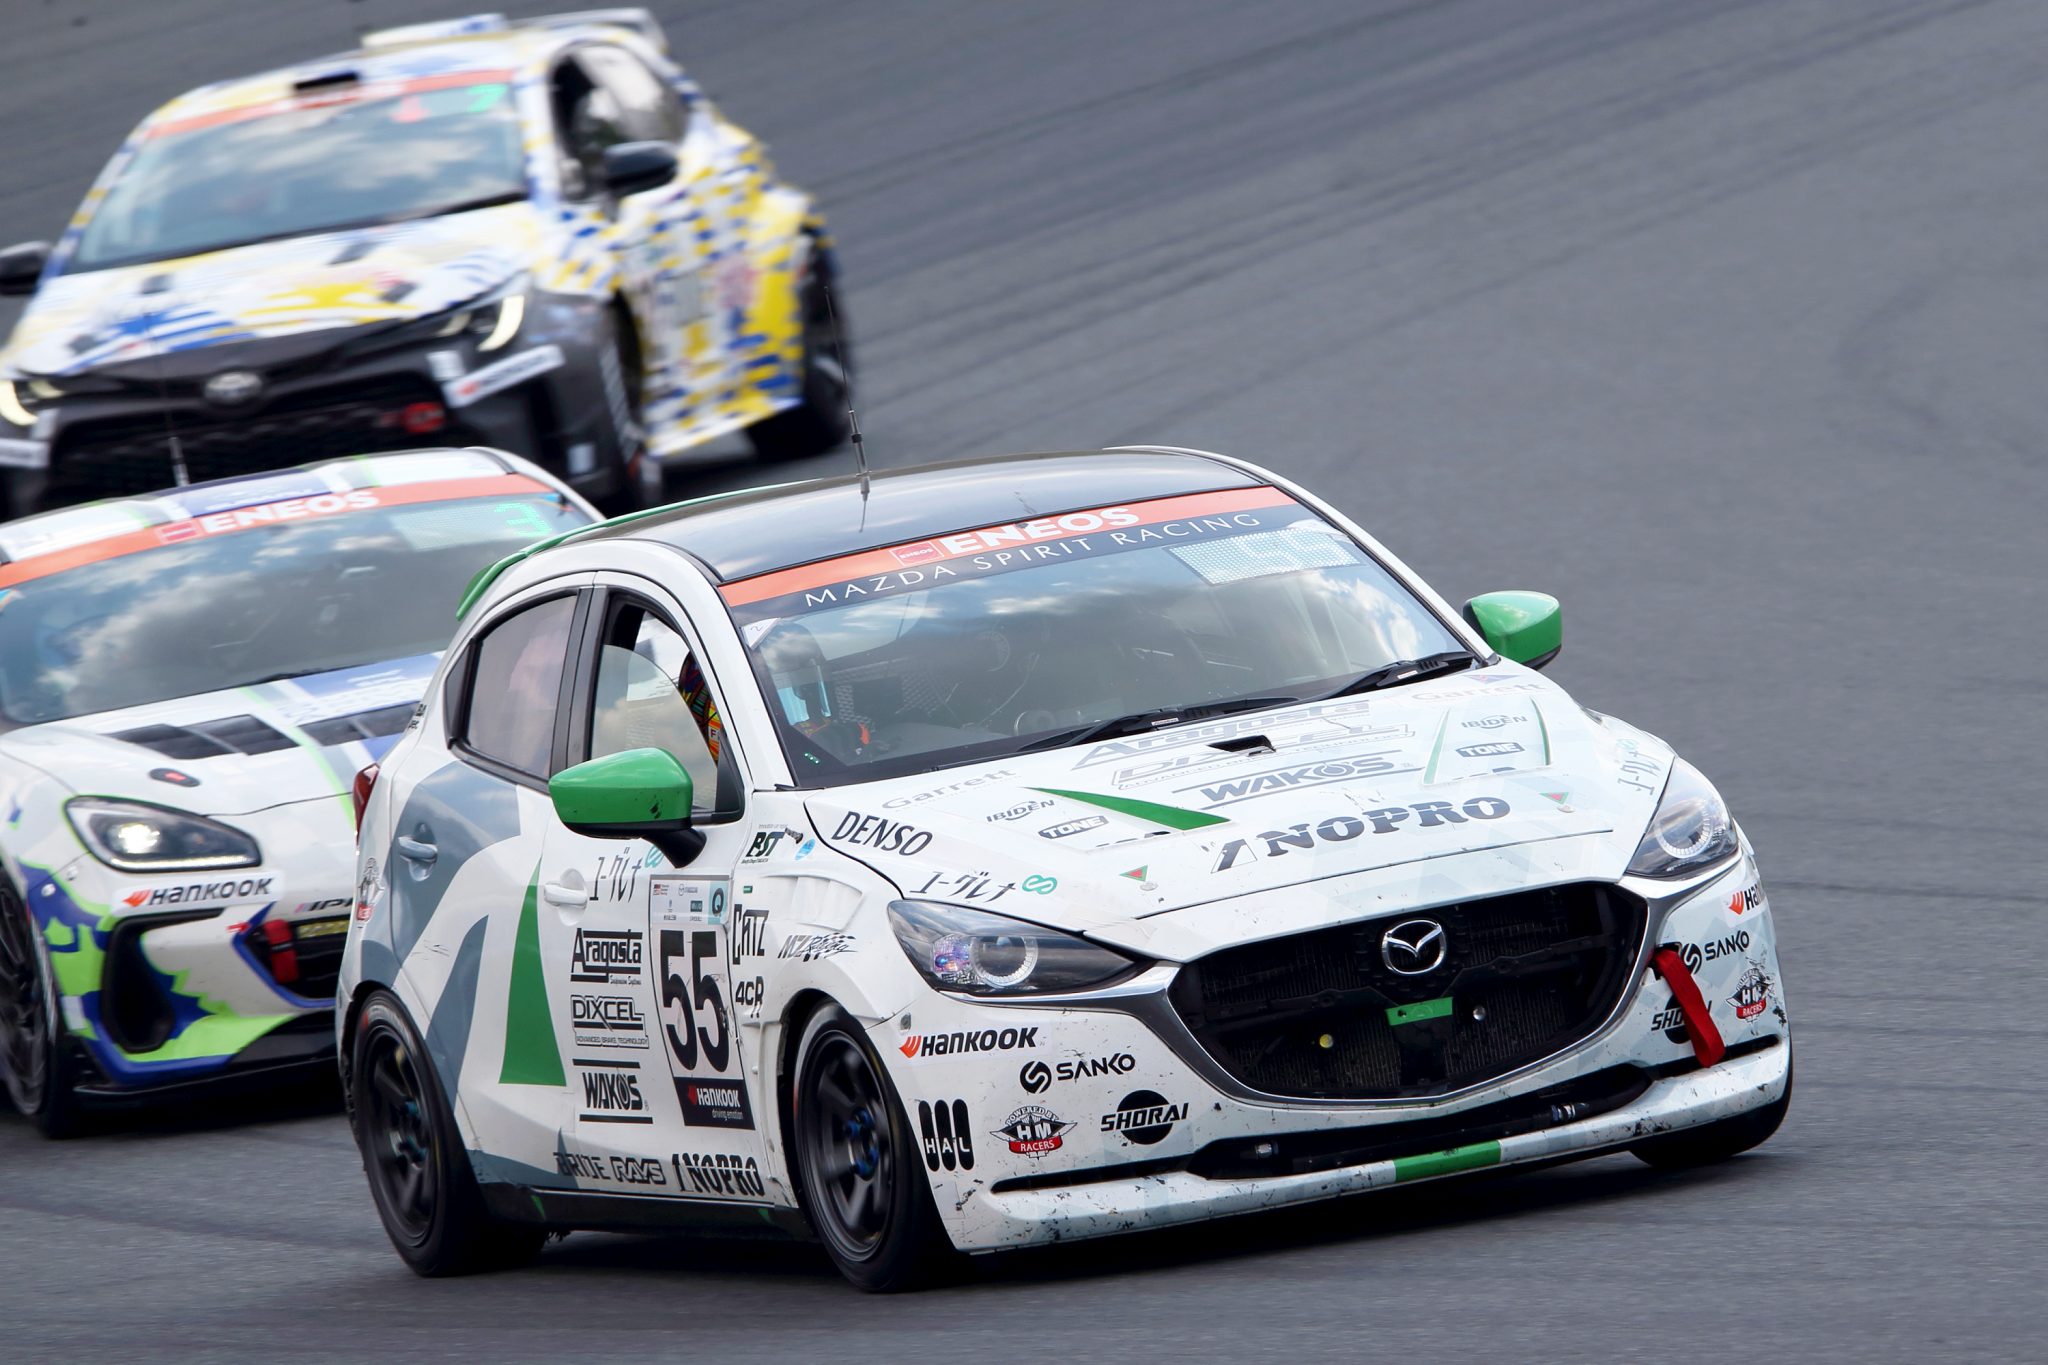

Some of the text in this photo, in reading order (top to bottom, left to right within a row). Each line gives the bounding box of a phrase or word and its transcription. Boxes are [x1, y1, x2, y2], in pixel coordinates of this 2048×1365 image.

[201, 490, 381, 531] ENEOS
[939, 507, 1140, 554] ENEOS
[805, 513, 1262, 607] MAZDA SPIRIT RACING
[1461, 715, 1528, 729] IBIDEN
[1461, 743, 1517, 756] TONE
[882, 768, 1016, 810] Garrett
[985, 800, 1055, 823] IBIDEN
[832, 811, 933, 857] DENSO
[1044, 817, 1106, 839] TONE
[1256, 796, 1511, 858] NOPRO
[745, 831, 786, 858] BST
[571, 927, 643, 982] Aragosta
[1704, 930, 1750, 962] SANKO
[572, 997, 645, 1023] DIXCEL
[660, 929, 730, 1073] 55
[1651, 1000, 1712, 1031] SHOI
[1742, 1000, 1764, 1017] RACERS
[1056, 1052, 1136, 1081] SANKO
[1005, 1105, 1046, 1126] POWERED
[1100, 1102, 1189, 1132] SHORAI
[1016, 1122, 1052, 1141] HM
[1020, 1139, 1055, 1152] RACERS
[610, 1156, 667, 1185] RAYS
[682, 1152, 766, 1196] NOPRO
